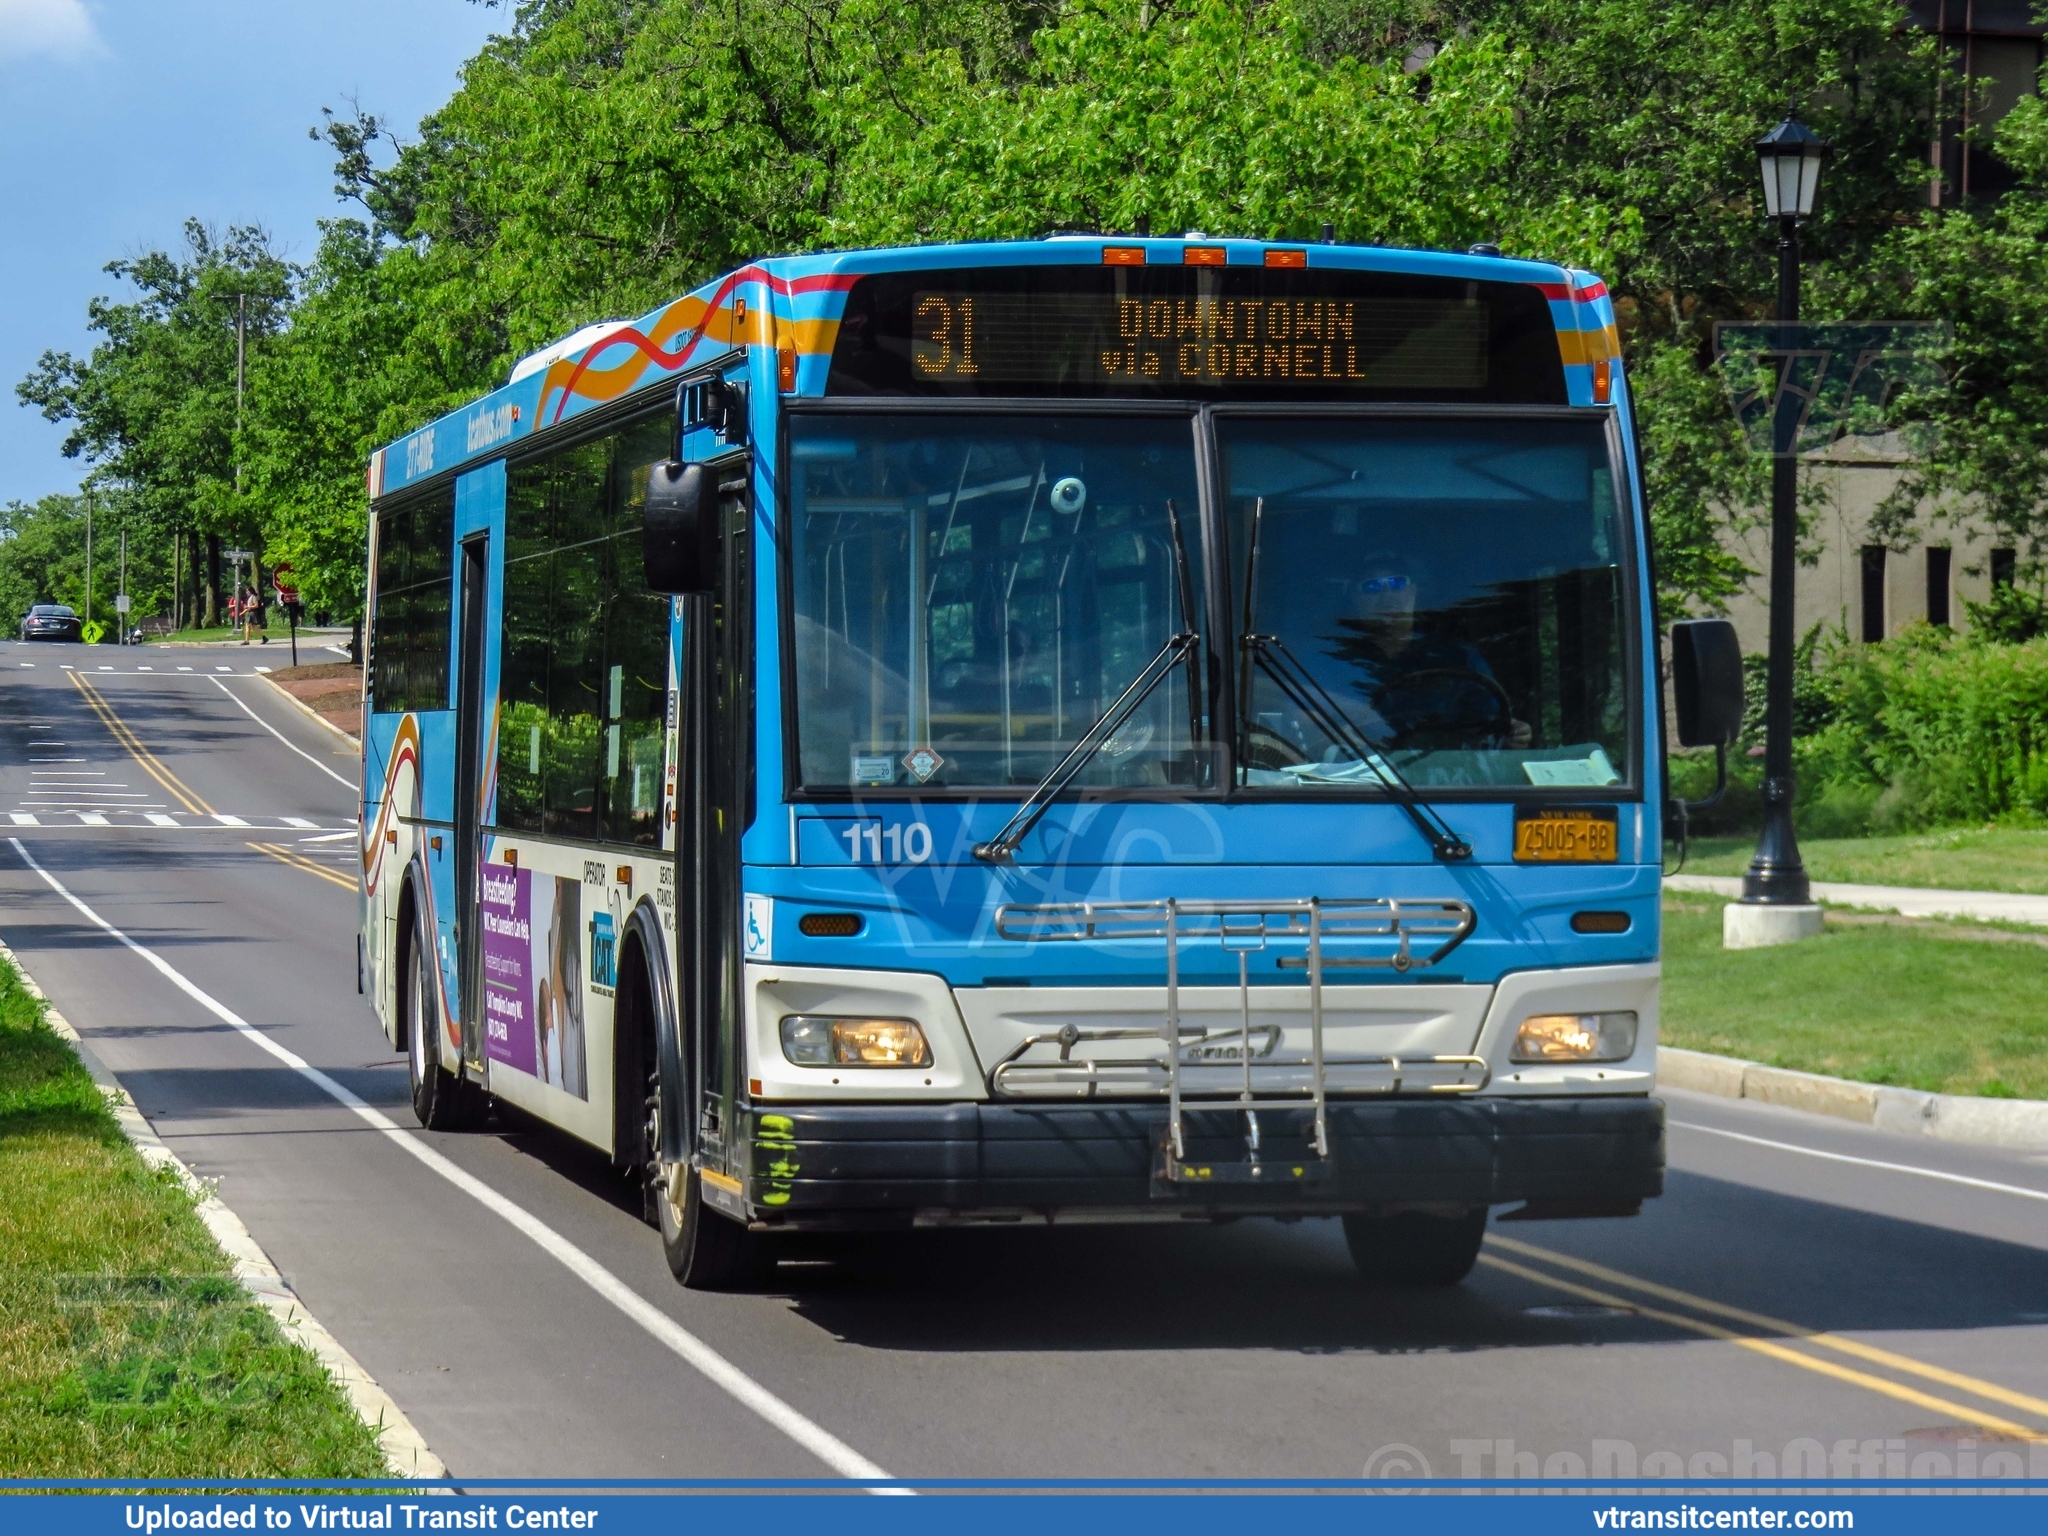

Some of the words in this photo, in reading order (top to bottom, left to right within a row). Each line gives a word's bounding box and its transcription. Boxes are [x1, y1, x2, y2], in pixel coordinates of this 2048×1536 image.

[917, 297, 979, 373] 31
[1120, 299, 1353, 339] DOWNTOWN
[1101, 343, 1160, 375] via
[1178, 343, 1365, 377] CORNELL
[842, 822, 933, 863] 1110
[583, 860, 606, 887] OPERATOR
[659, 866, 672, 885] SEATS
[484, 873, 517, 915] Breastfeeding?
[656, 888, 672, 907] STANDS
